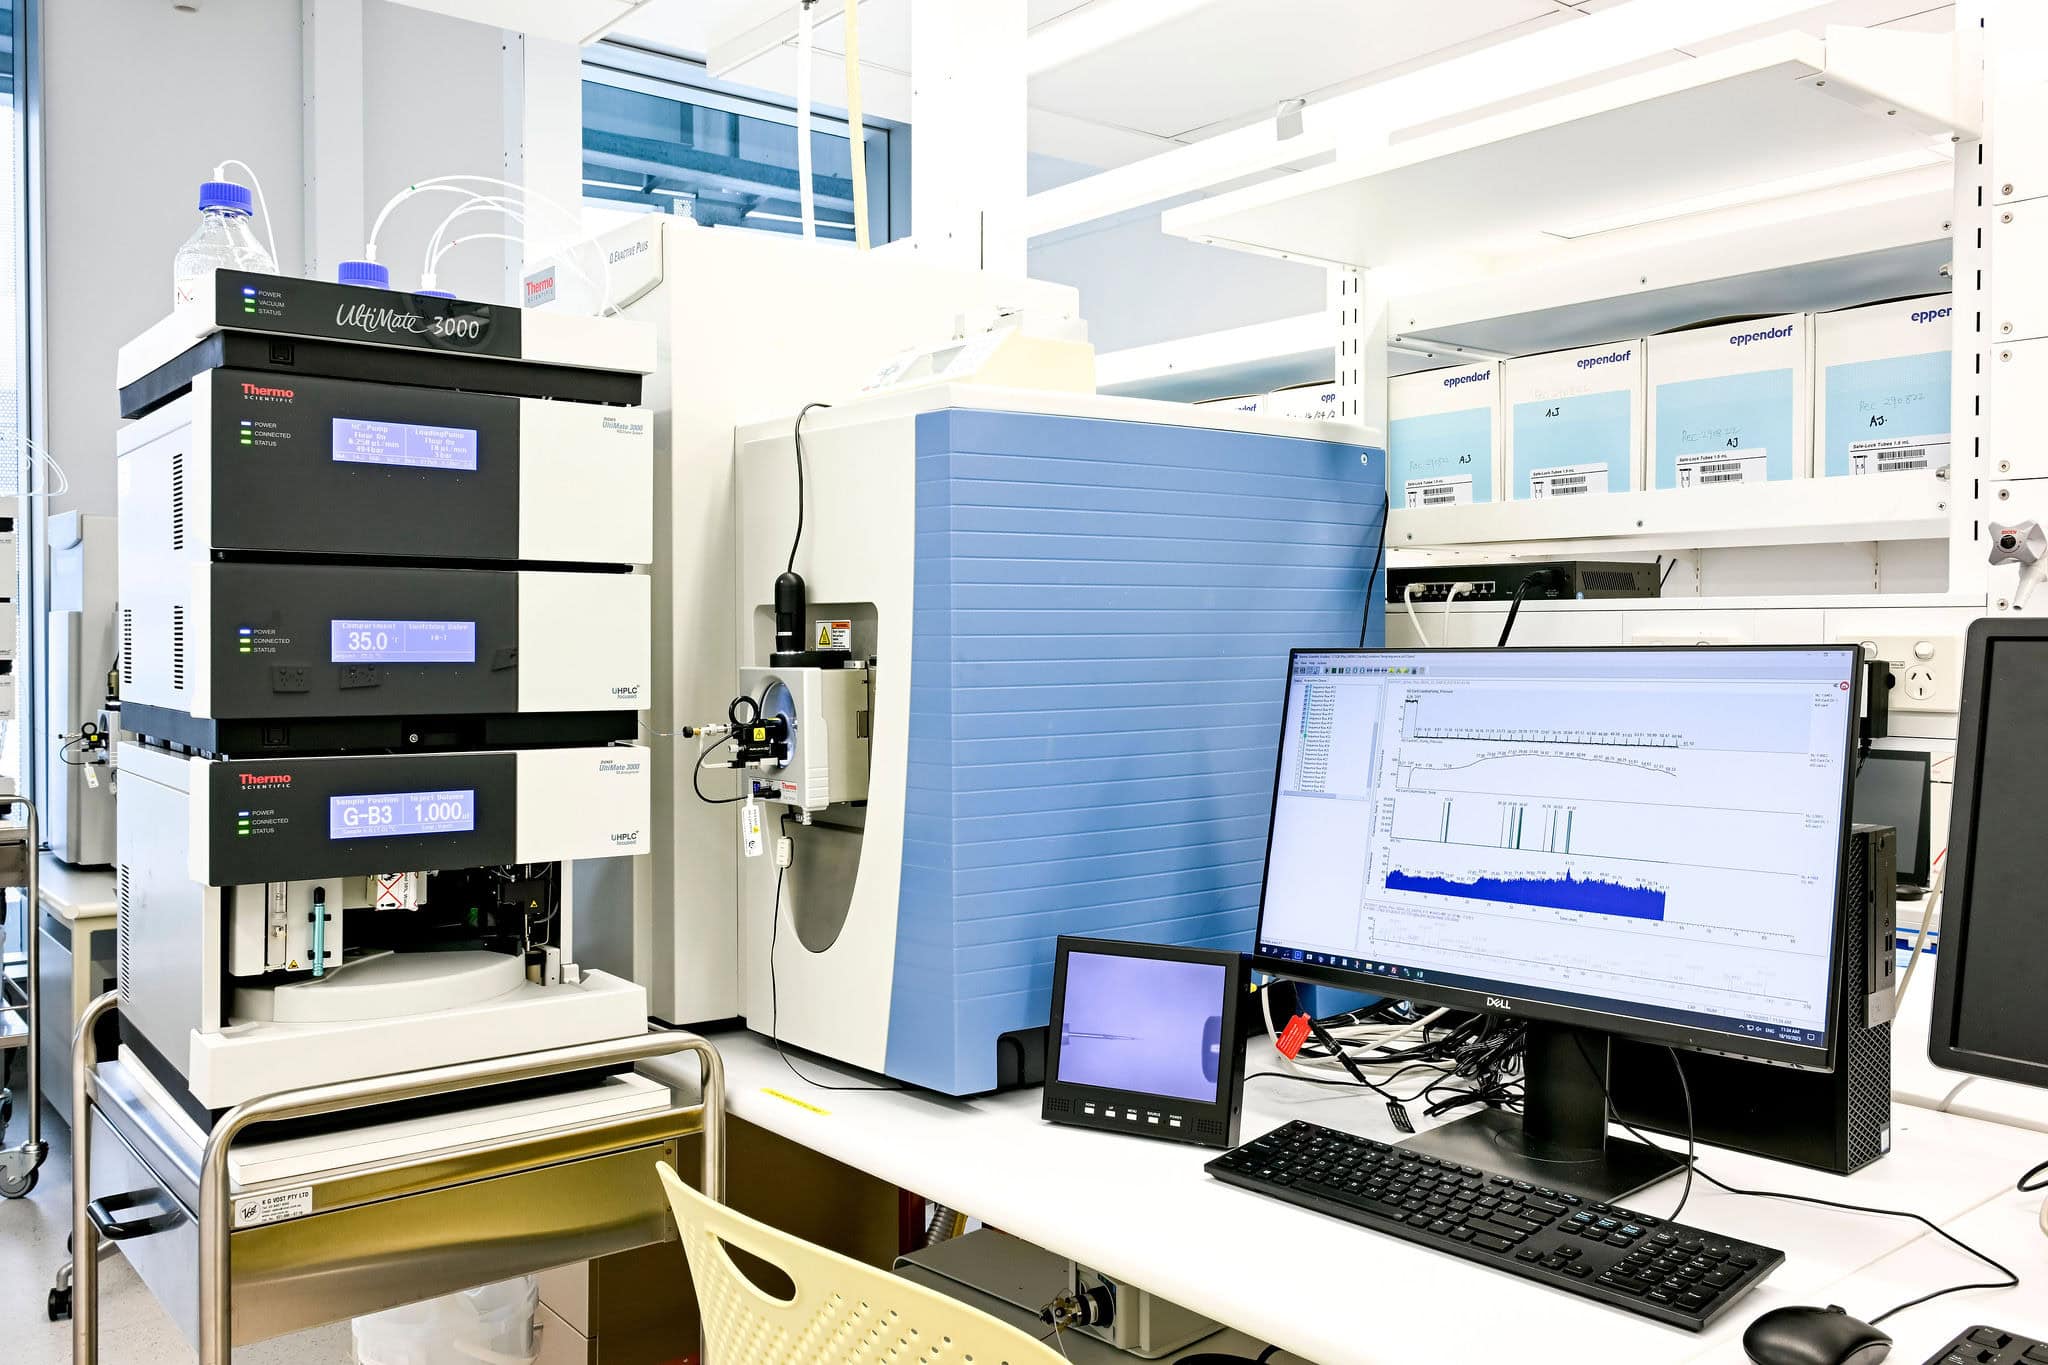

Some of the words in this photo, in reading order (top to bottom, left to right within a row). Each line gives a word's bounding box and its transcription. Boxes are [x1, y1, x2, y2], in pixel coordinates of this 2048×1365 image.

[258, 290, 282, 298] POWER
[526, 277, 554, 296] Thermo
[258, 299, 285, 308] VACUUM
[258, 308, 282, 317] STATUS
[336, 303, 429, 333] UltiMate
[433, 316, 480, 339] 3000
[1729, 325, 1793, 346] eppendorf
[1577, 350, 1631, 369] eppendorf
[1443, 370, 1491, 388] eppendorf
[241, 383, 294, 398] Thermo
[244, 395, 293, 404] SCIENTIFIC
[254, 430, 291, 439] CONNECTED
[348, 631, 388, 651] 35.0
[239, 773, 292, 785] Thermo
[343, 805, 392, 826] G-B3
[414, 802, 461, 823] 1.000
[252, 827, 275, 835] STATUS
[1486, 996, 1511, 1010] DELL
